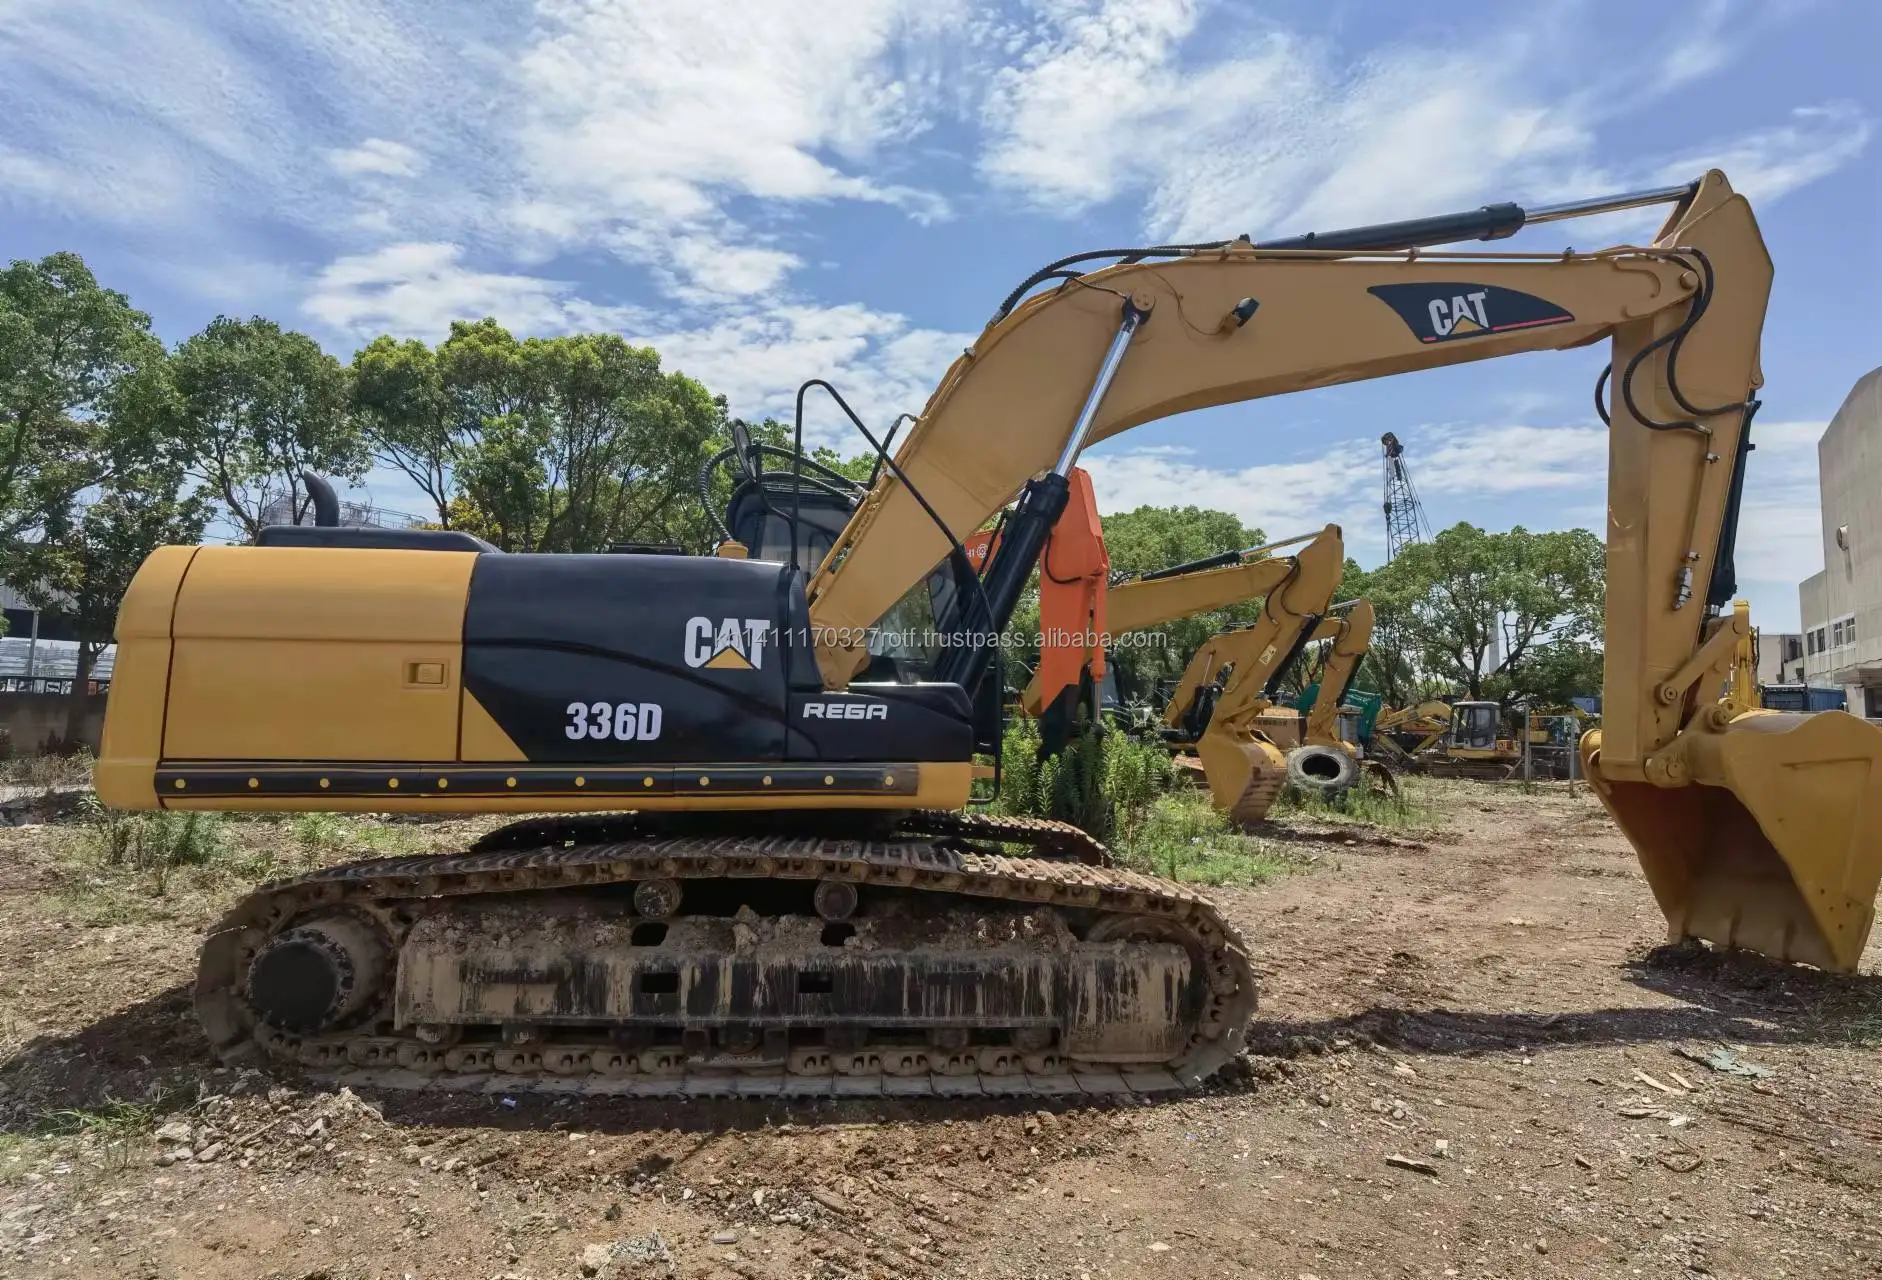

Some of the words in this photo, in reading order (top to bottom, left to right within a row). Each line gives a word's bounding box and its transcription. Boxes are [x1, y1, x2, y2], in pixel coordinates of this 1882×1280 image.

[1428, 291, 1489, 336] CAT
[684, 616, 771, 670] CAT
[565, 702, 662, 741] 336D
[803, 703, 888, 720] REGA
